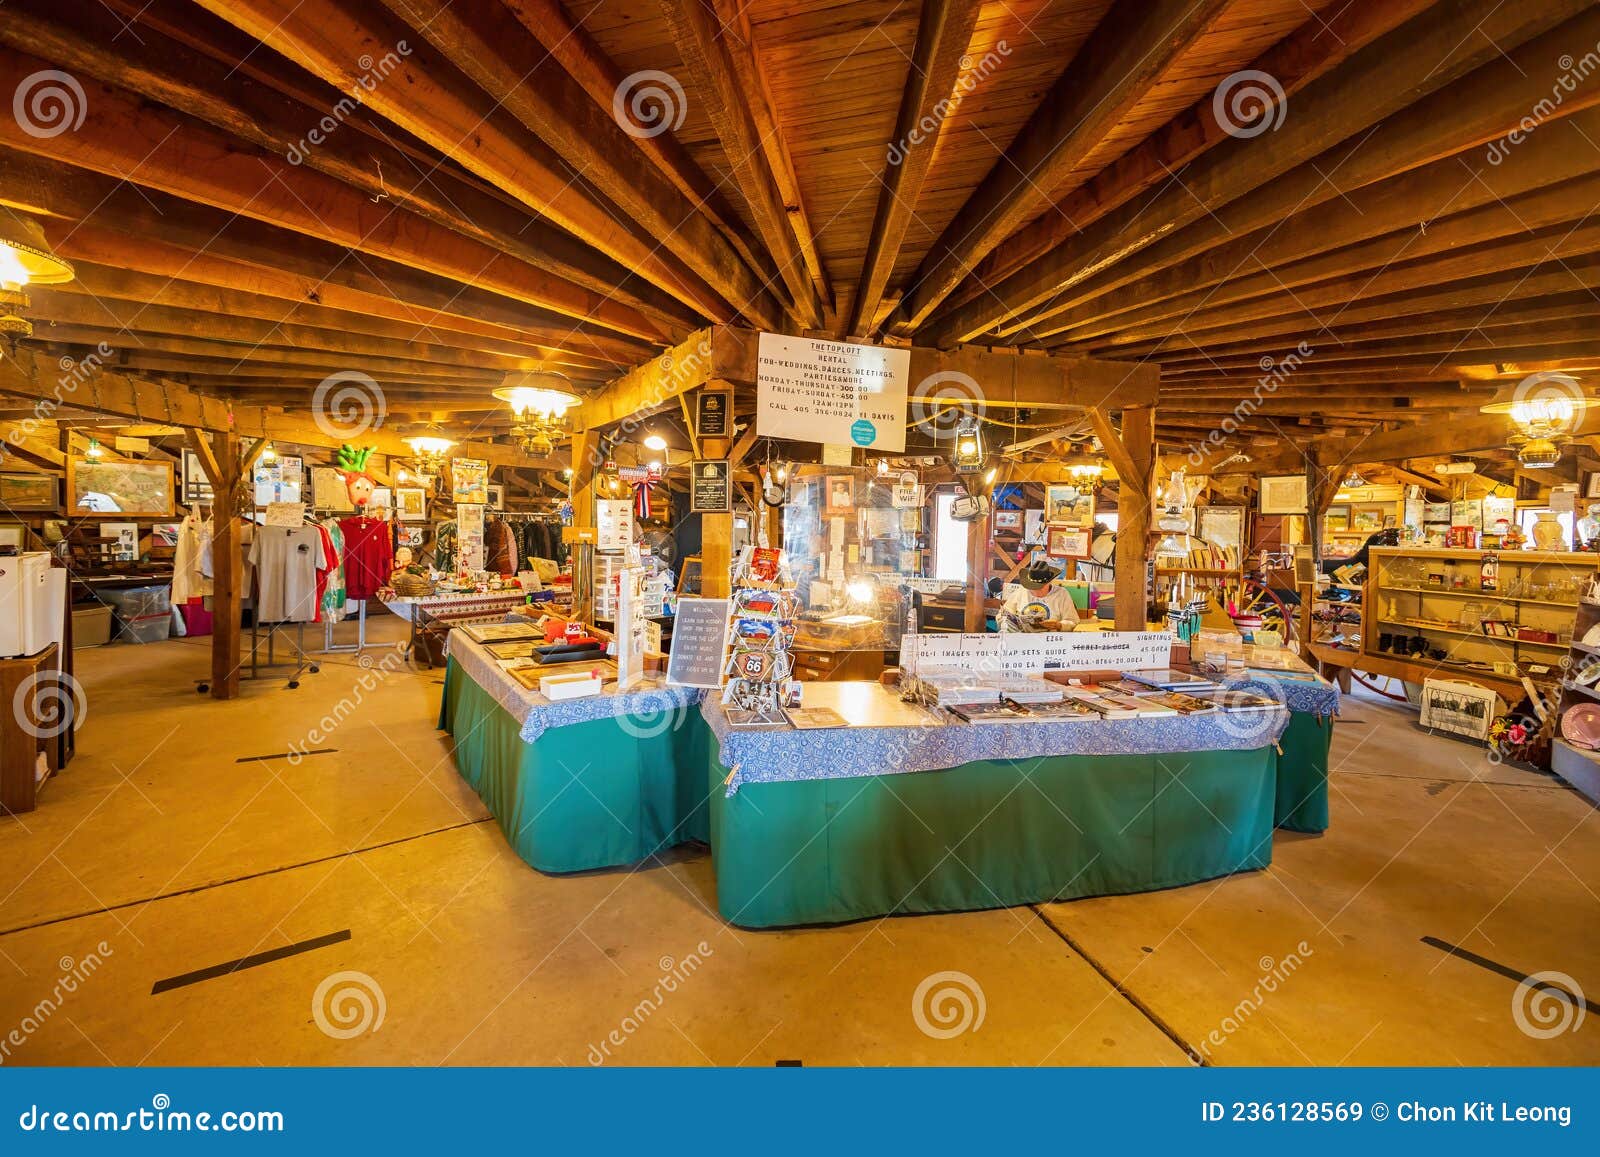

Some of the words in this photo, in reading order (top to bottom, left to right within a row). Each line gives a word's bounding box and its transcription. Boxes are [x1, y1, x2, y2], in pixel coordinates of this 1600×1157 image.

[818, 355, 847, 364] RENTAL
[769, 402, 788, 411] CALL
[794, 405, 809, 413] 405
[871, 413, 895, 421] DAVIS
[746, 659, 761, 672] 66
